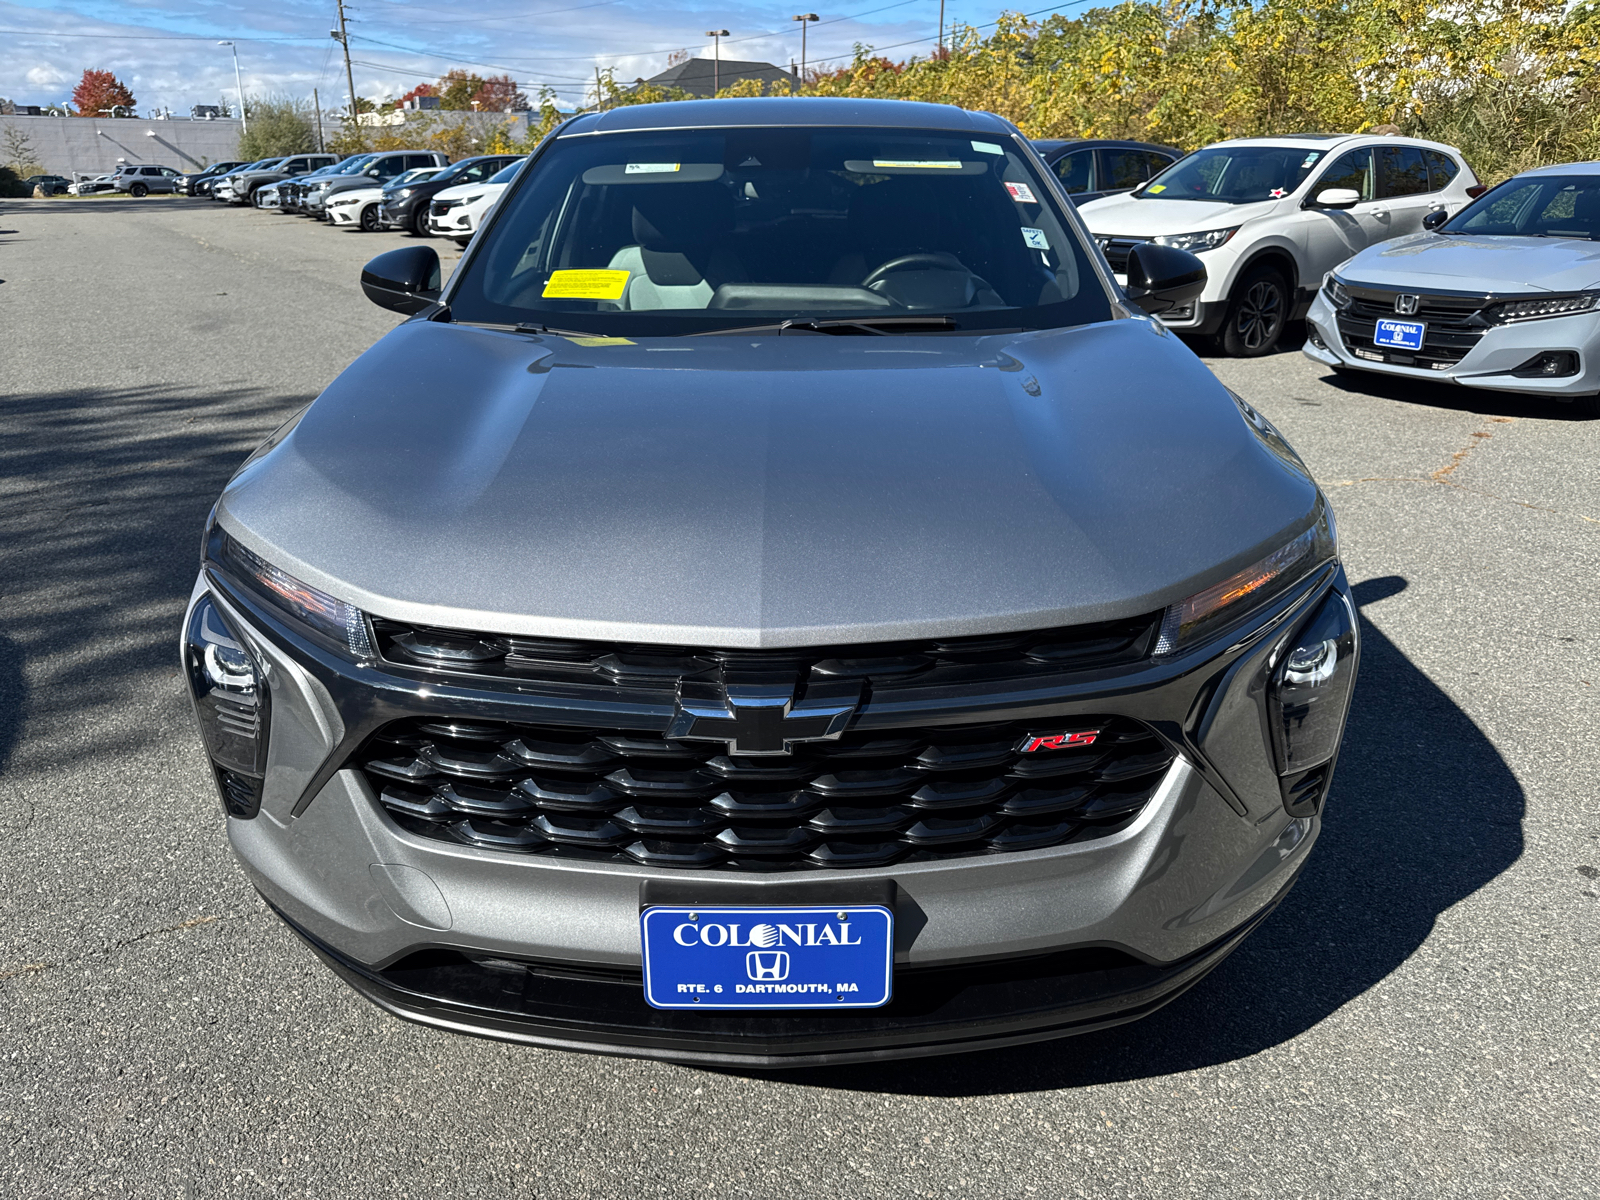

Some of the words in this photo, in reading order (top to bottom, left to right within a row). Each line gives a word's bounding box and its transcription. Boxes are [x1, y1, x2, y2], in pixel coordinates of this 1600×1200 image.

[1381, 323, 1418, 334] COLONIAL
[1019, 730, 1100, 752] RS
[673, 923, 862, 948] COLONIAL
[677, 984, 710, 994] RTE.
[713, 984, 723, 994] 6
[735, 983, 833, 995] DARTMOUTH,
[836, 983, 859, 992] MA
